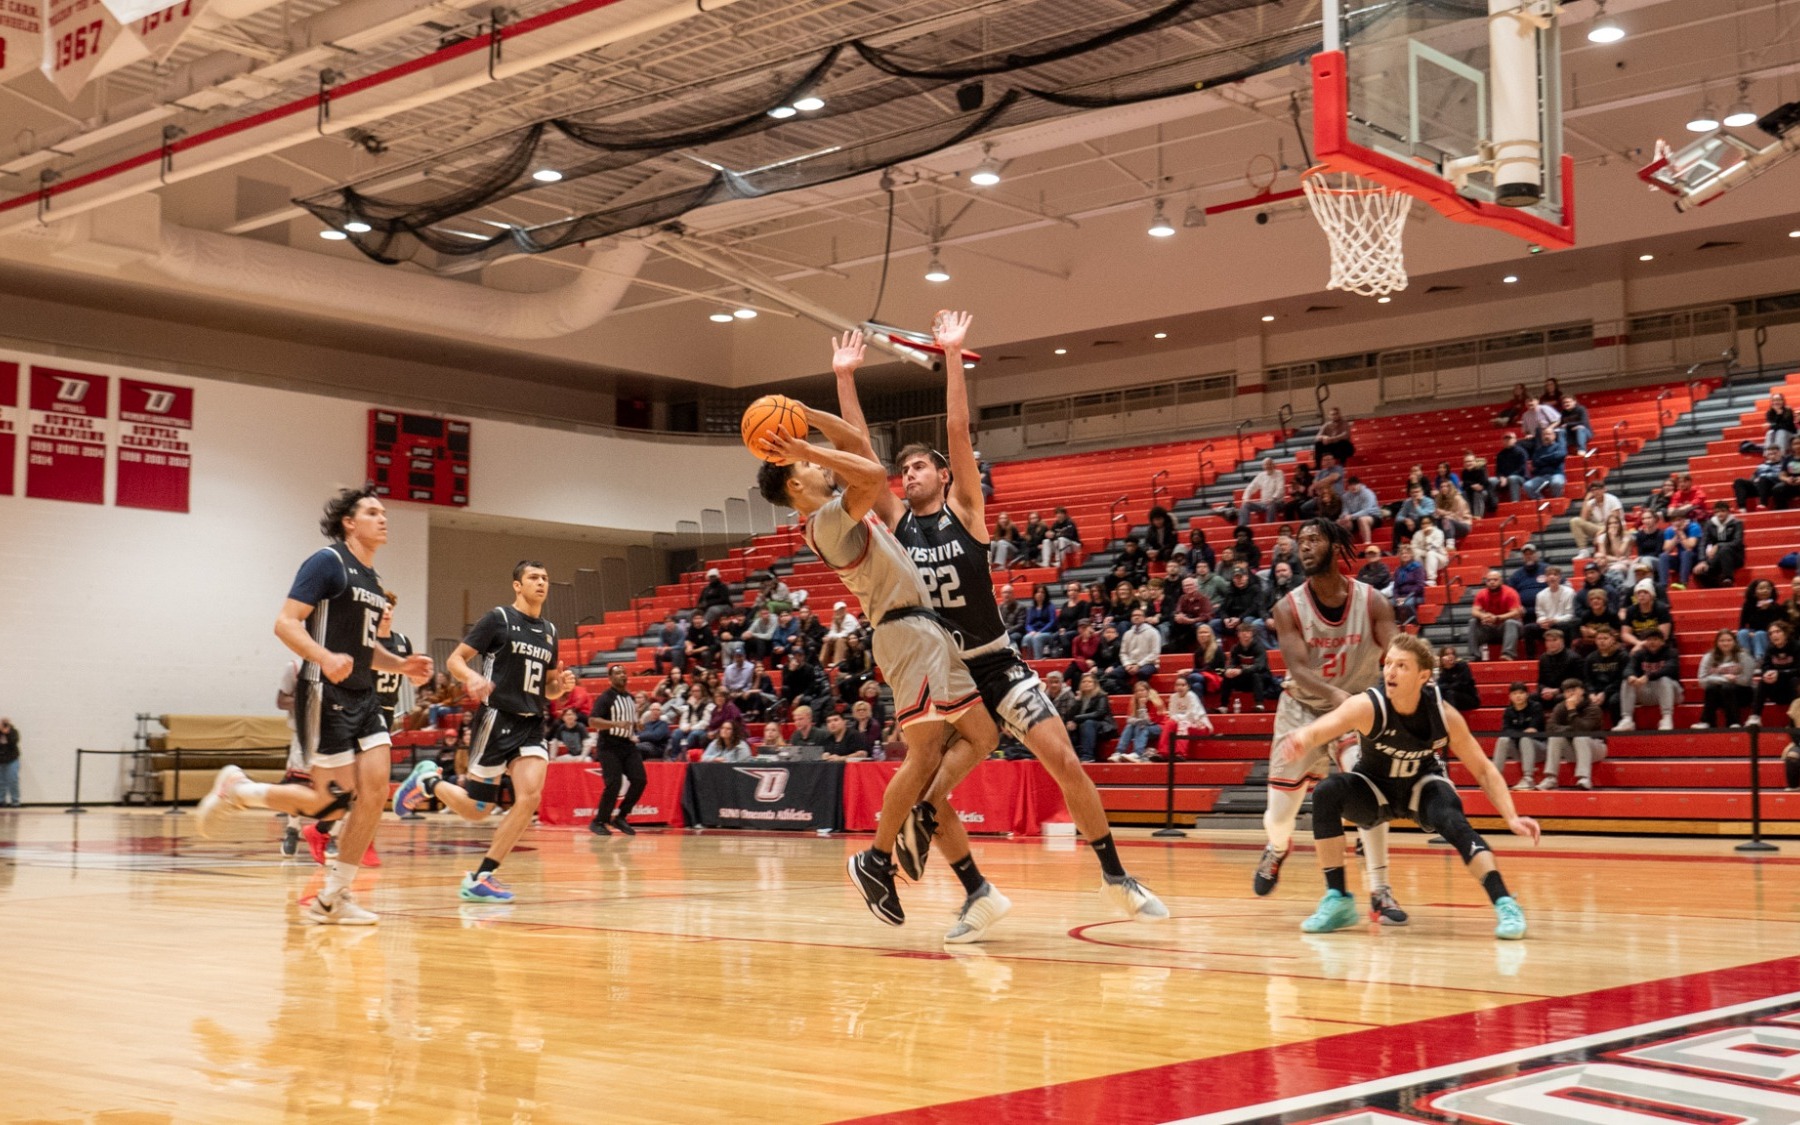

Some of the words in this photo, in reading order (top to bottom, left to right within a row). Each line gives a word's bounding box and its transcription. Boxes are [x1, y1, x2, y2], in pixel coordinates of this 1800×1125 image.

[55, 19, 103, 72] 1967
[352, 586, 387, 609] YESHIV
[918, 564, 967, 608] 22
[362, 607, 380, 649] 15
[511, 641, 552, 664] YESHIV
[1322, 652, 1347, 677] 21
[376, 669, 400, 693] 23
[523, 658, 543, 695] 12
[1374, 742, 1433, 759] YESHIV
[1388, 758, 1421, 778] 10
